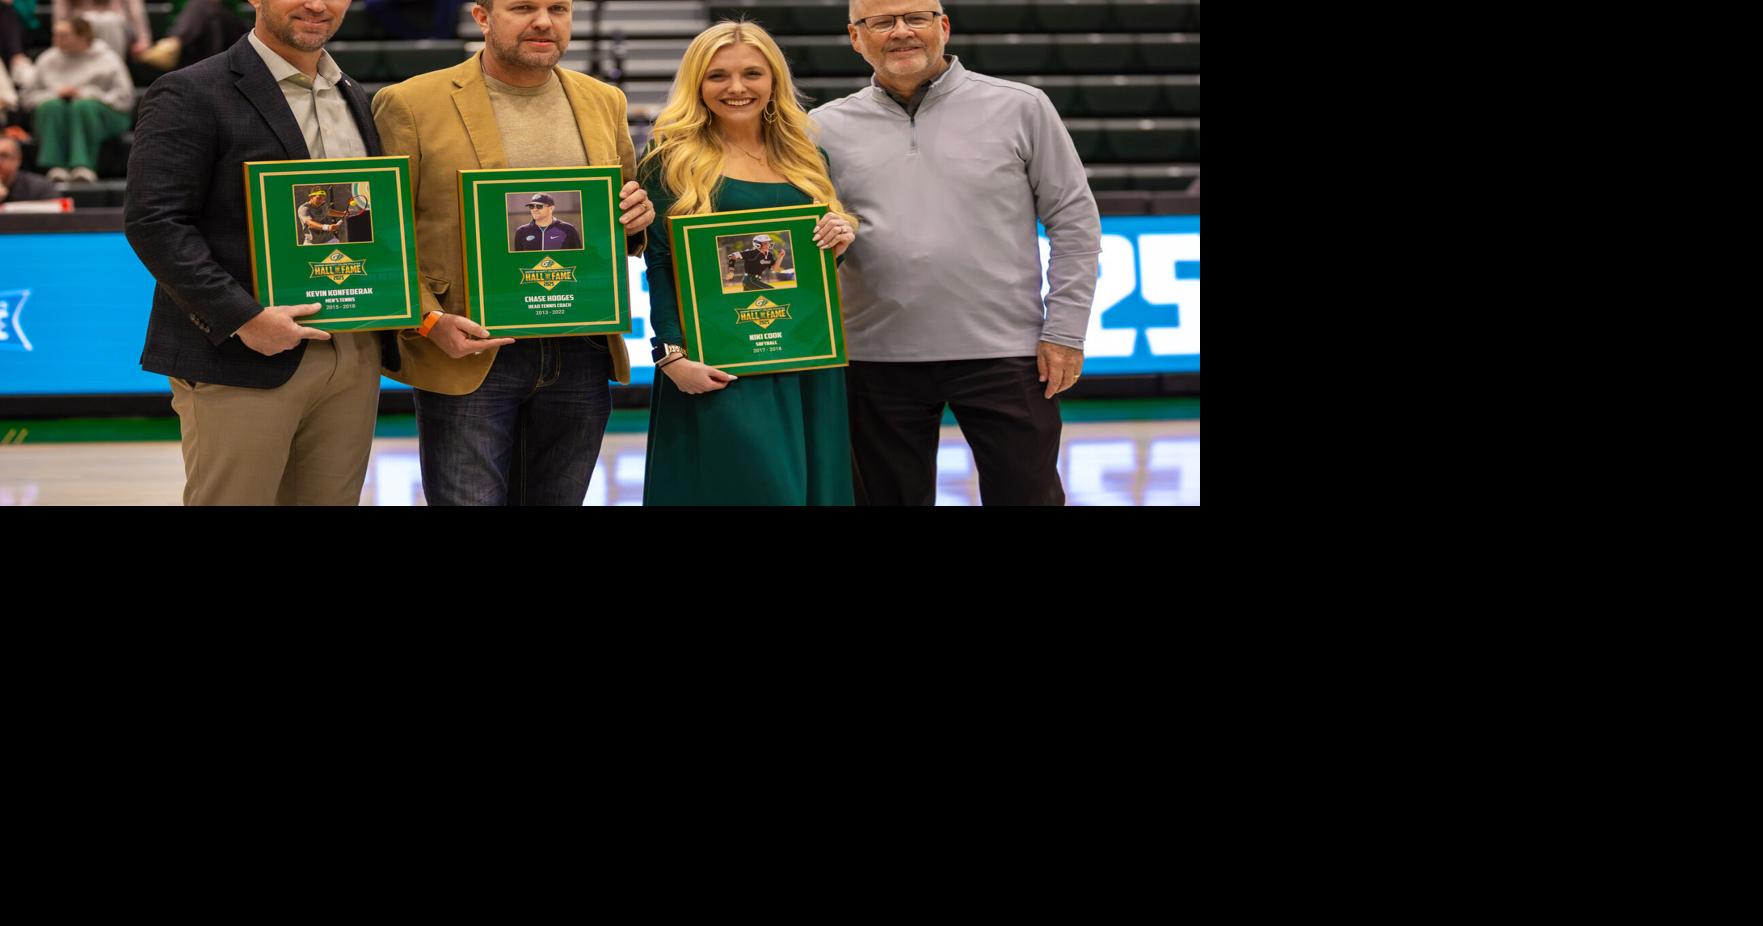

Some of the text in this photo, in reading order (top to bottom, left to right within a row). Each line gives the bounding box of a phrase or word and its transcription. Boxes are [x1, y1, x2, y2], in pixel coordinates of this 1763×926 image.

[314, 266, 334, 275] HALL
[341, 264, 362, 274] FAME
[526, 272, 544, 281] HALL
[552, 271, 572, 280] FAME
[328, 288, 373, 296] KONFEDERAK
[740, 312, 760, 321] HALL
[766, 309, 786, 319] FAME
